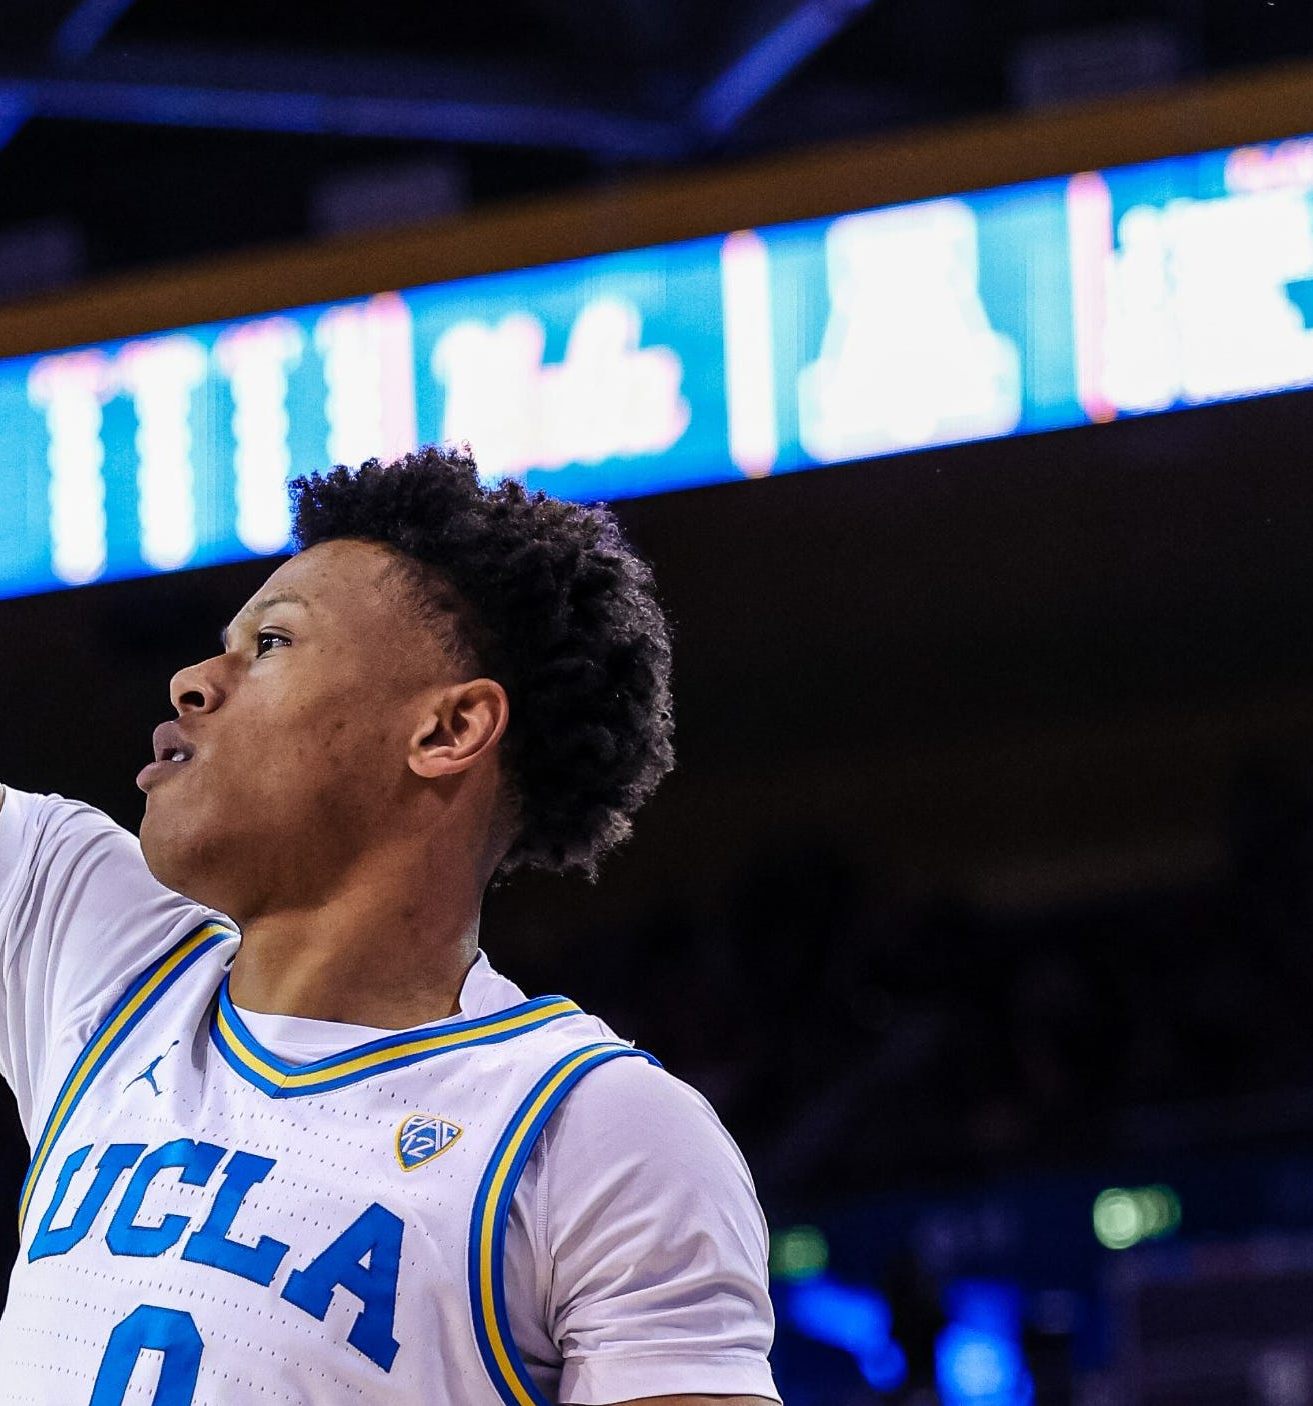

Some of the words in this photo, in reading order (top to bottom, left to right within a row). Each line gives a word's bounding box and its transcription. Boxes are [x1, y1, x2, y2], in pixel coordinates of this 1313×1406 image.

[401, 1116, 459, 1151] PAC
[401, 1134, 435, 1158] 12
[28, 1138, 405, 1374] UCLA
